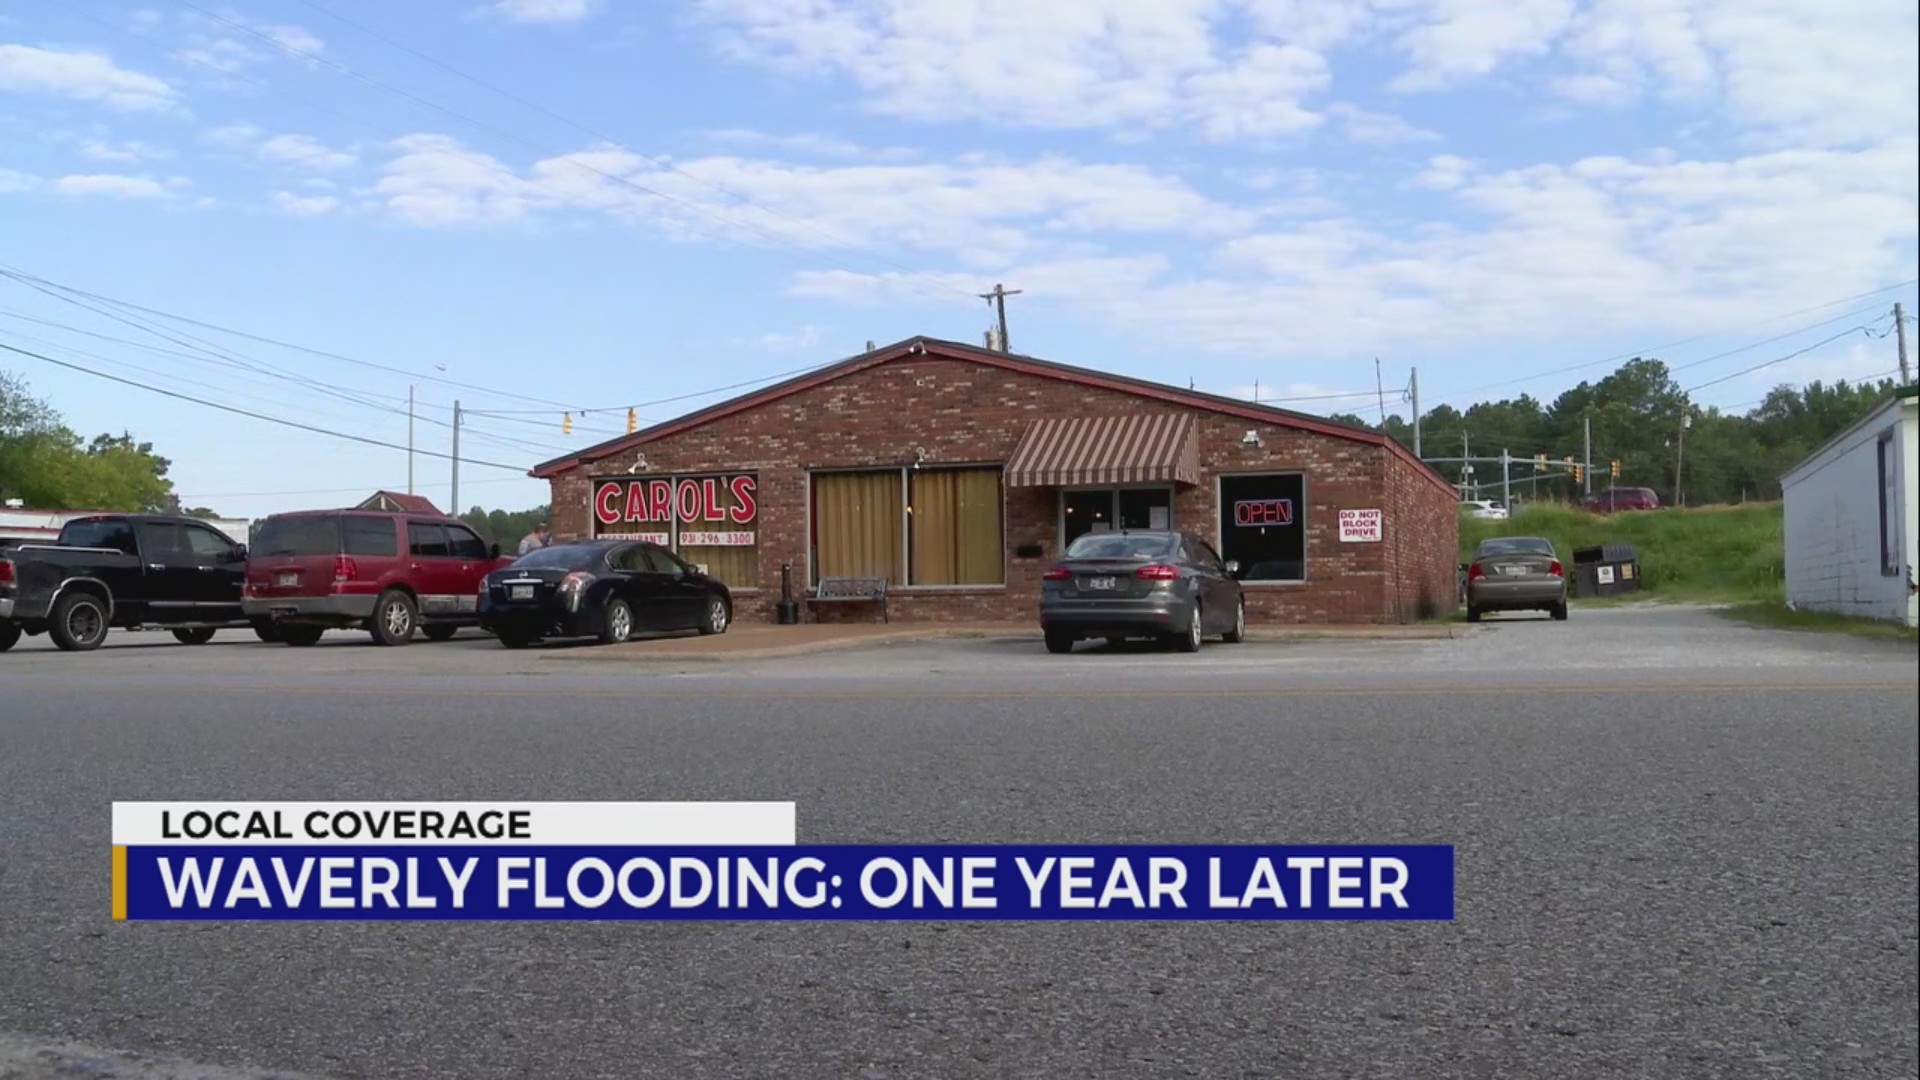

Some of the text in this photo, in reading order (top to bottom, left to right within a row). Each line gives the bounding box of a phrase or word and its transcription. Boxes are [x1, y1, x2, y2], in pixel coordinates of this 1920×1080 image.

[595, 475, 757, 524] CAROL'S
[1237, 501, 1291, 524] OPEN
[1340, 511, 1356, 519] DO
[1345, 528, 1377, 536] DRIVE
